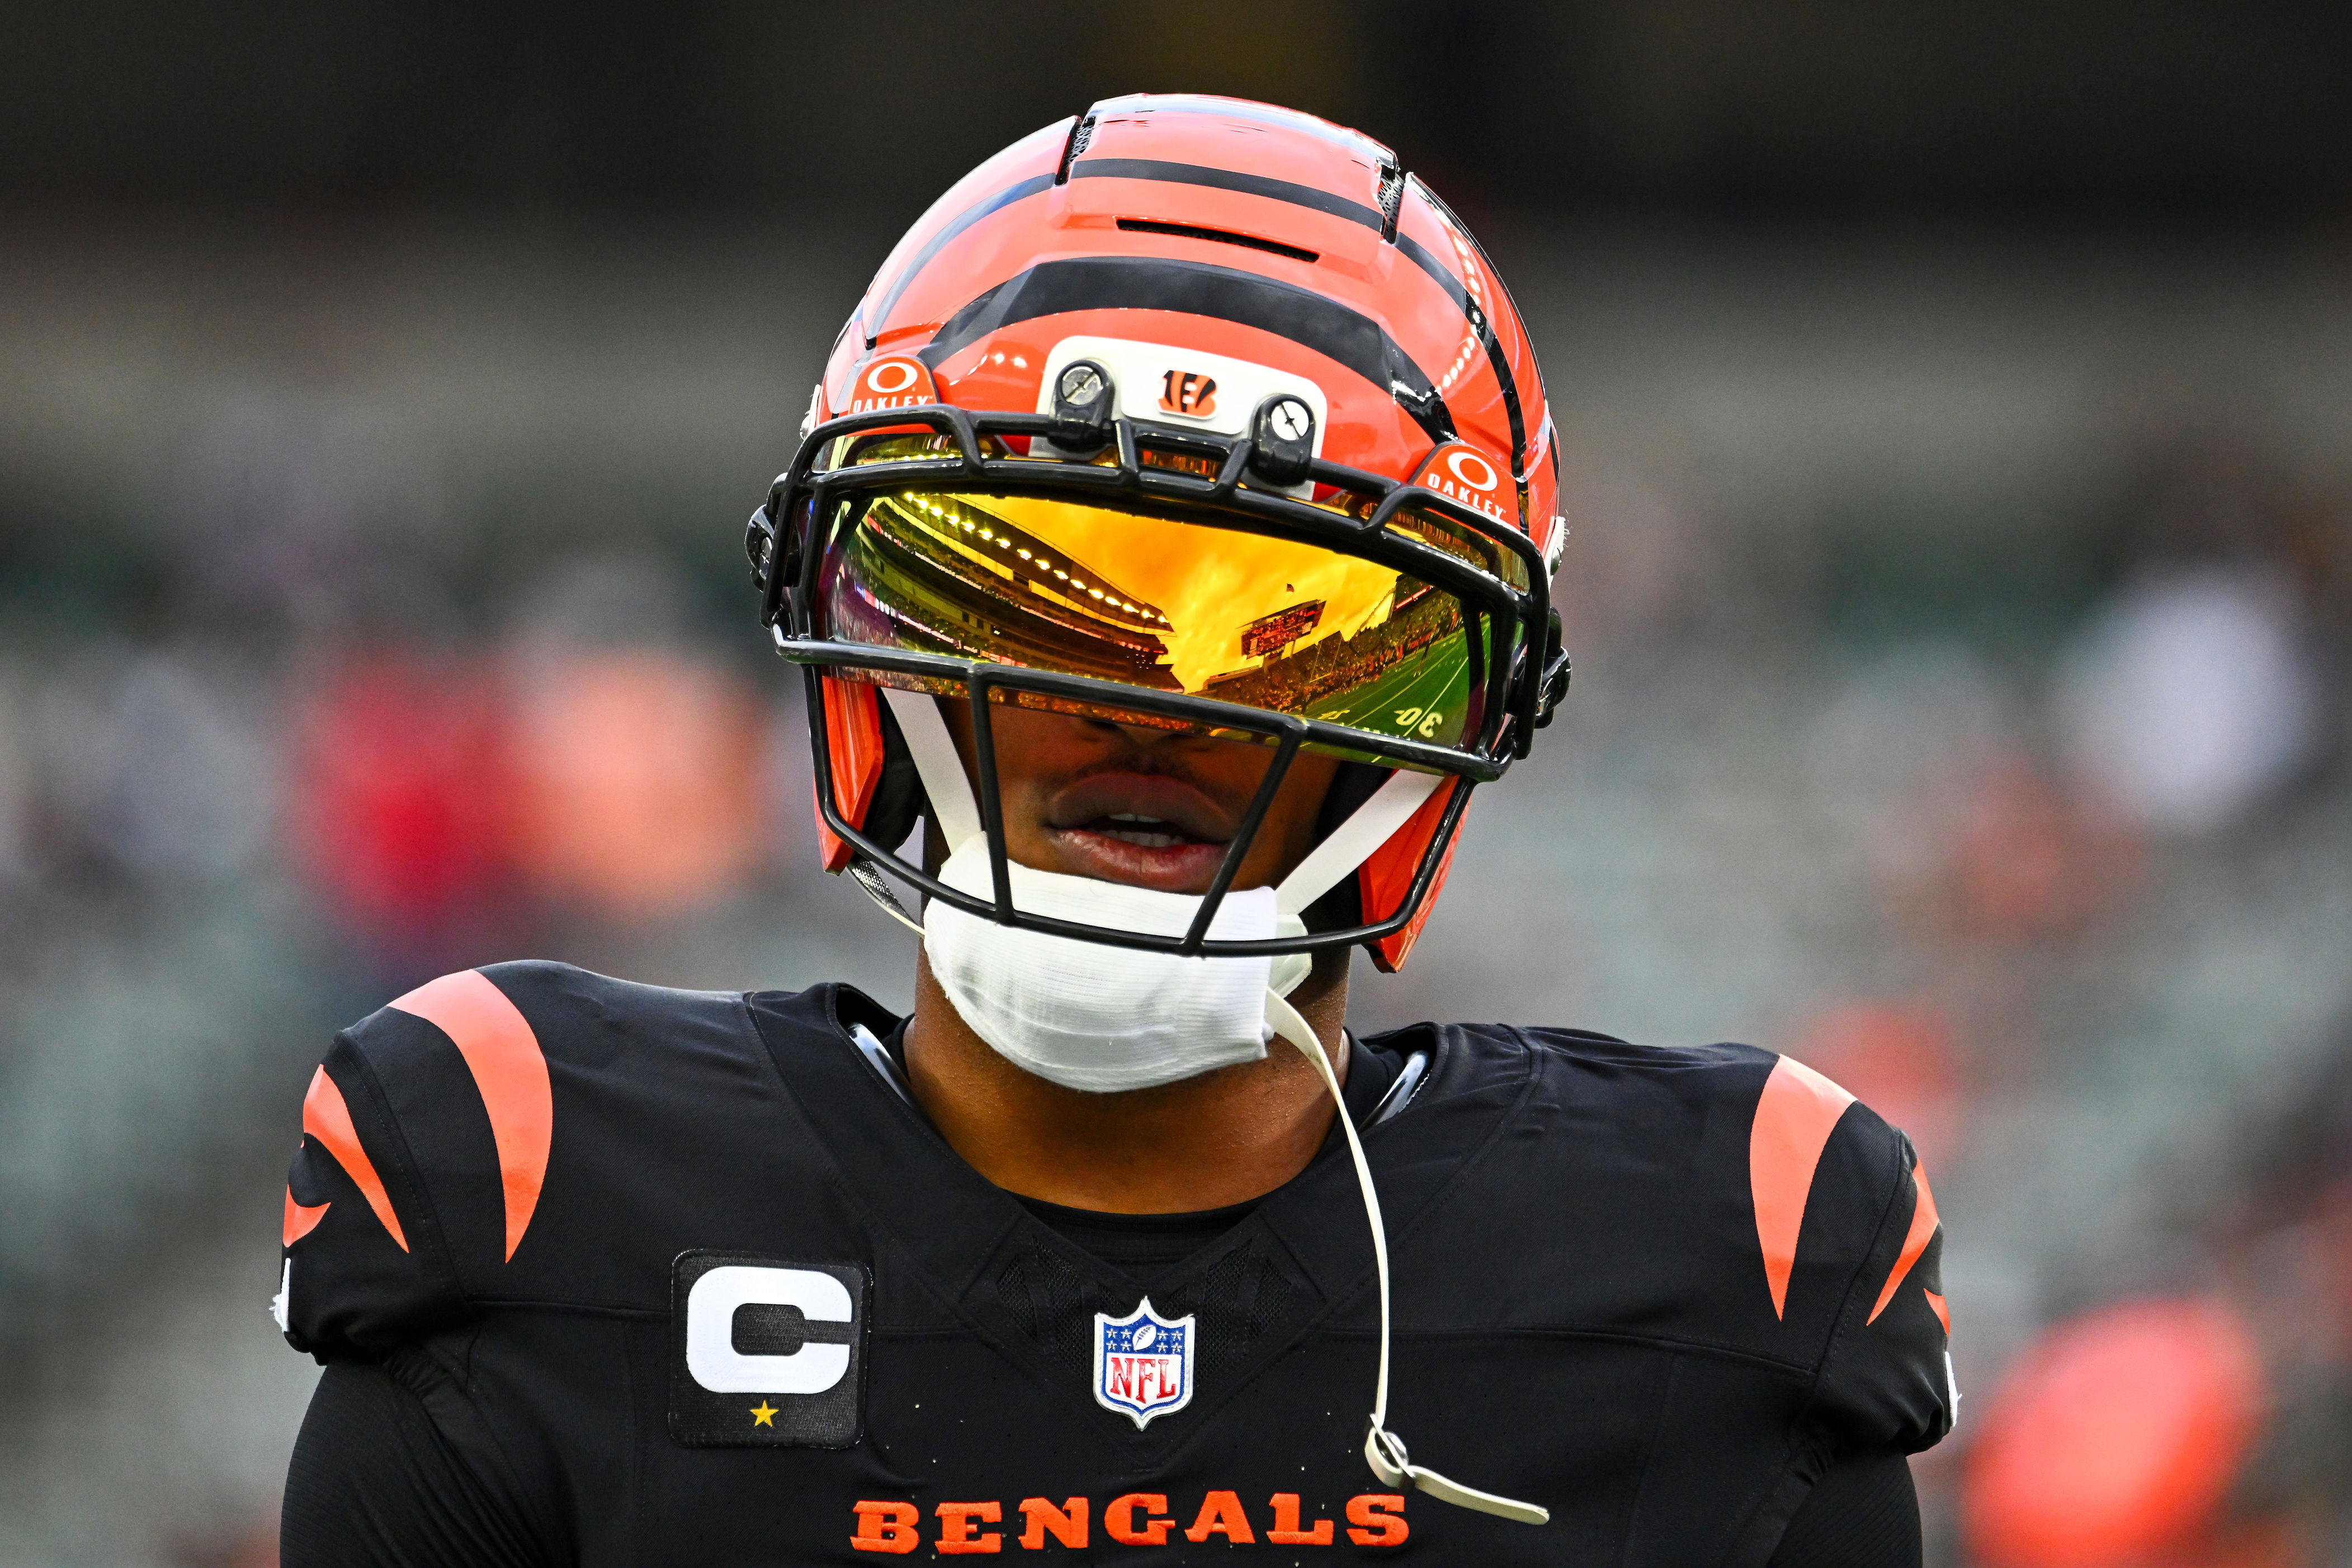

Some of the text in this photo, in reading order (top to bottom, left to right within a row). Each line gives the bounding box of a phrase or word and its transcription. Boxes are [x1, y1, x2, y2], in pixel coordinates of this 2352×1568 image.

[852, 395, 928, 413] OAKLEY
[1427, 473, 1504, 519] OAKLEY
[686, 1265, 852, 1394] C
[1110, 1357, 1176, 1404] NFL
[850, 1490, 1410, 1555] BENGALS
